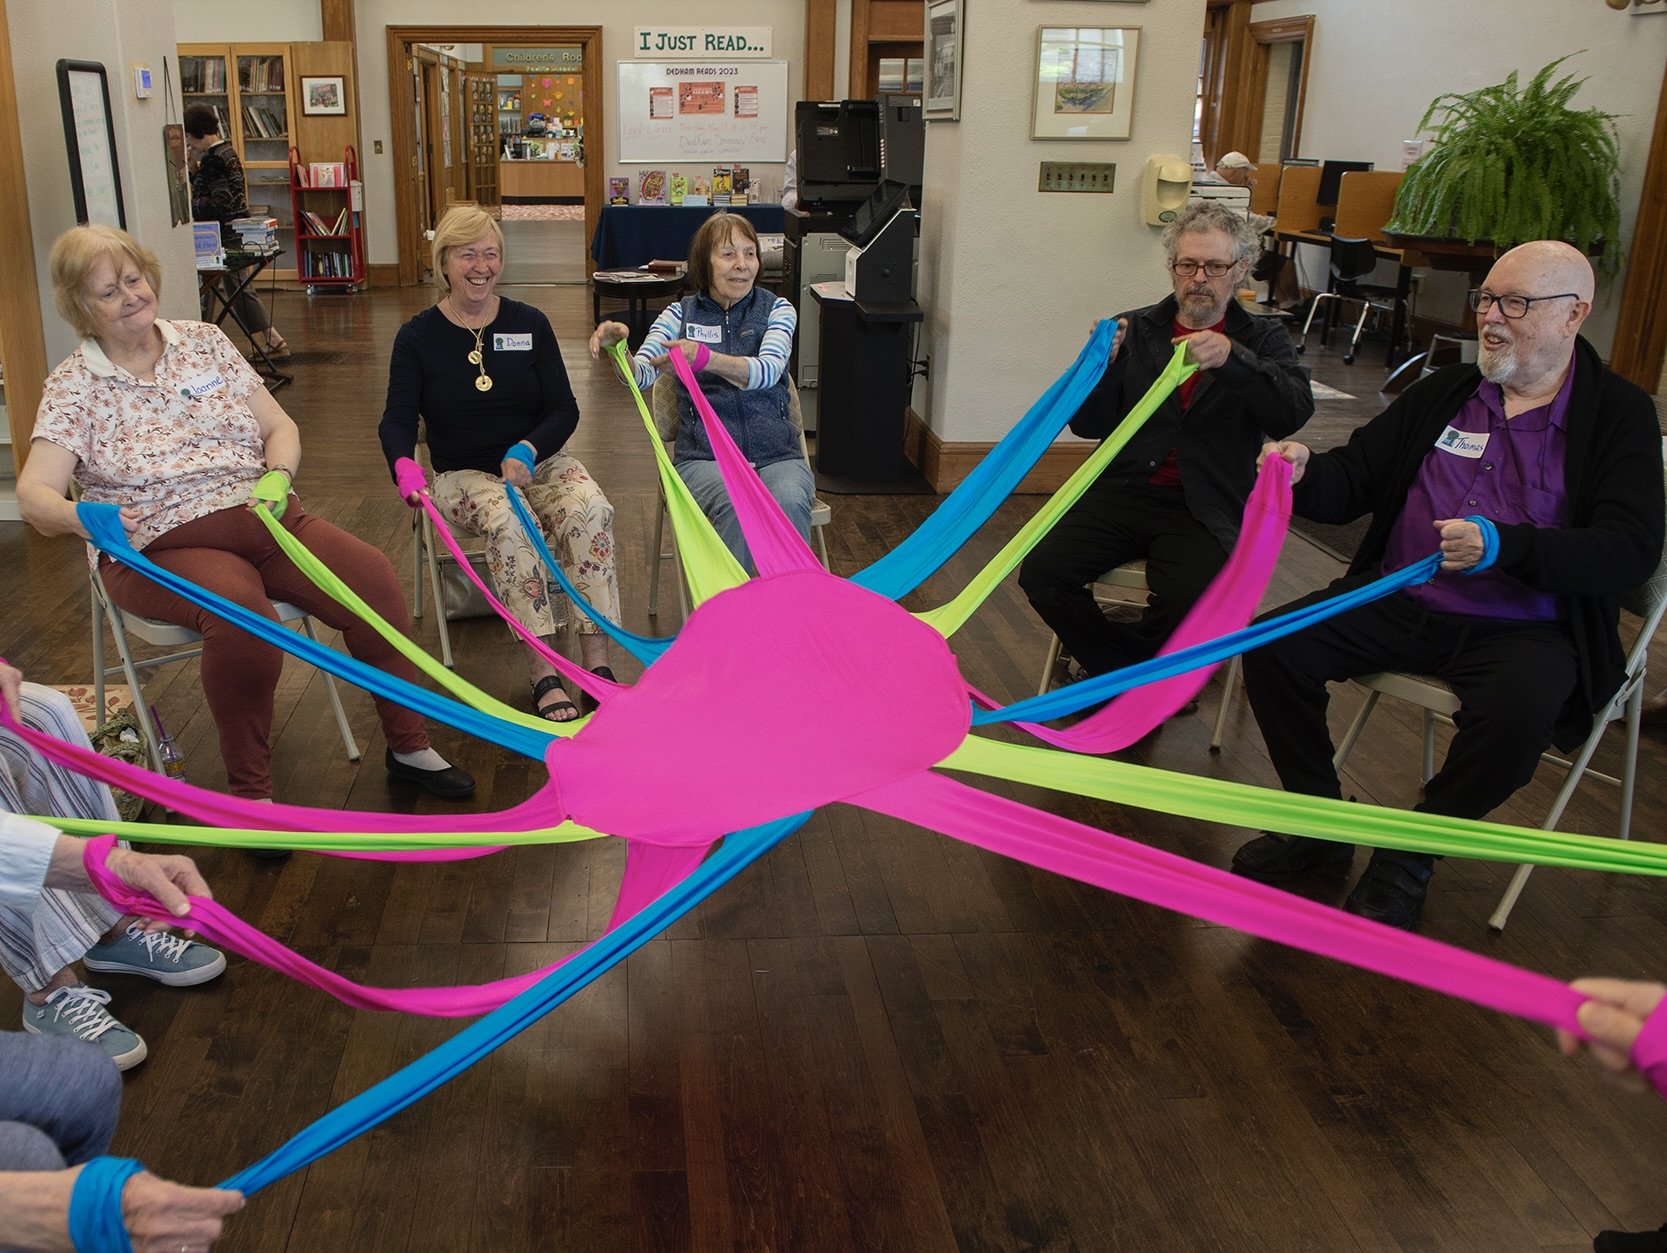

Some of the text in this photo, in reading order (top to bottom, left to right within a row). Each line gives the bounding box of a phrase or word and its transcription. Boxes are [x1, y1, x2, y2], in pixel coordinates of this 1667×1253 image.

[639, 32, 765, 52] I JUST READ...
[505, 52, 582, 62] Children's Roo
[666, 67, 739, 76] DEDHAM READS 2023
[506, 337, 531, 347] Donna
[1454, 436, 1484, 451] Thomas
